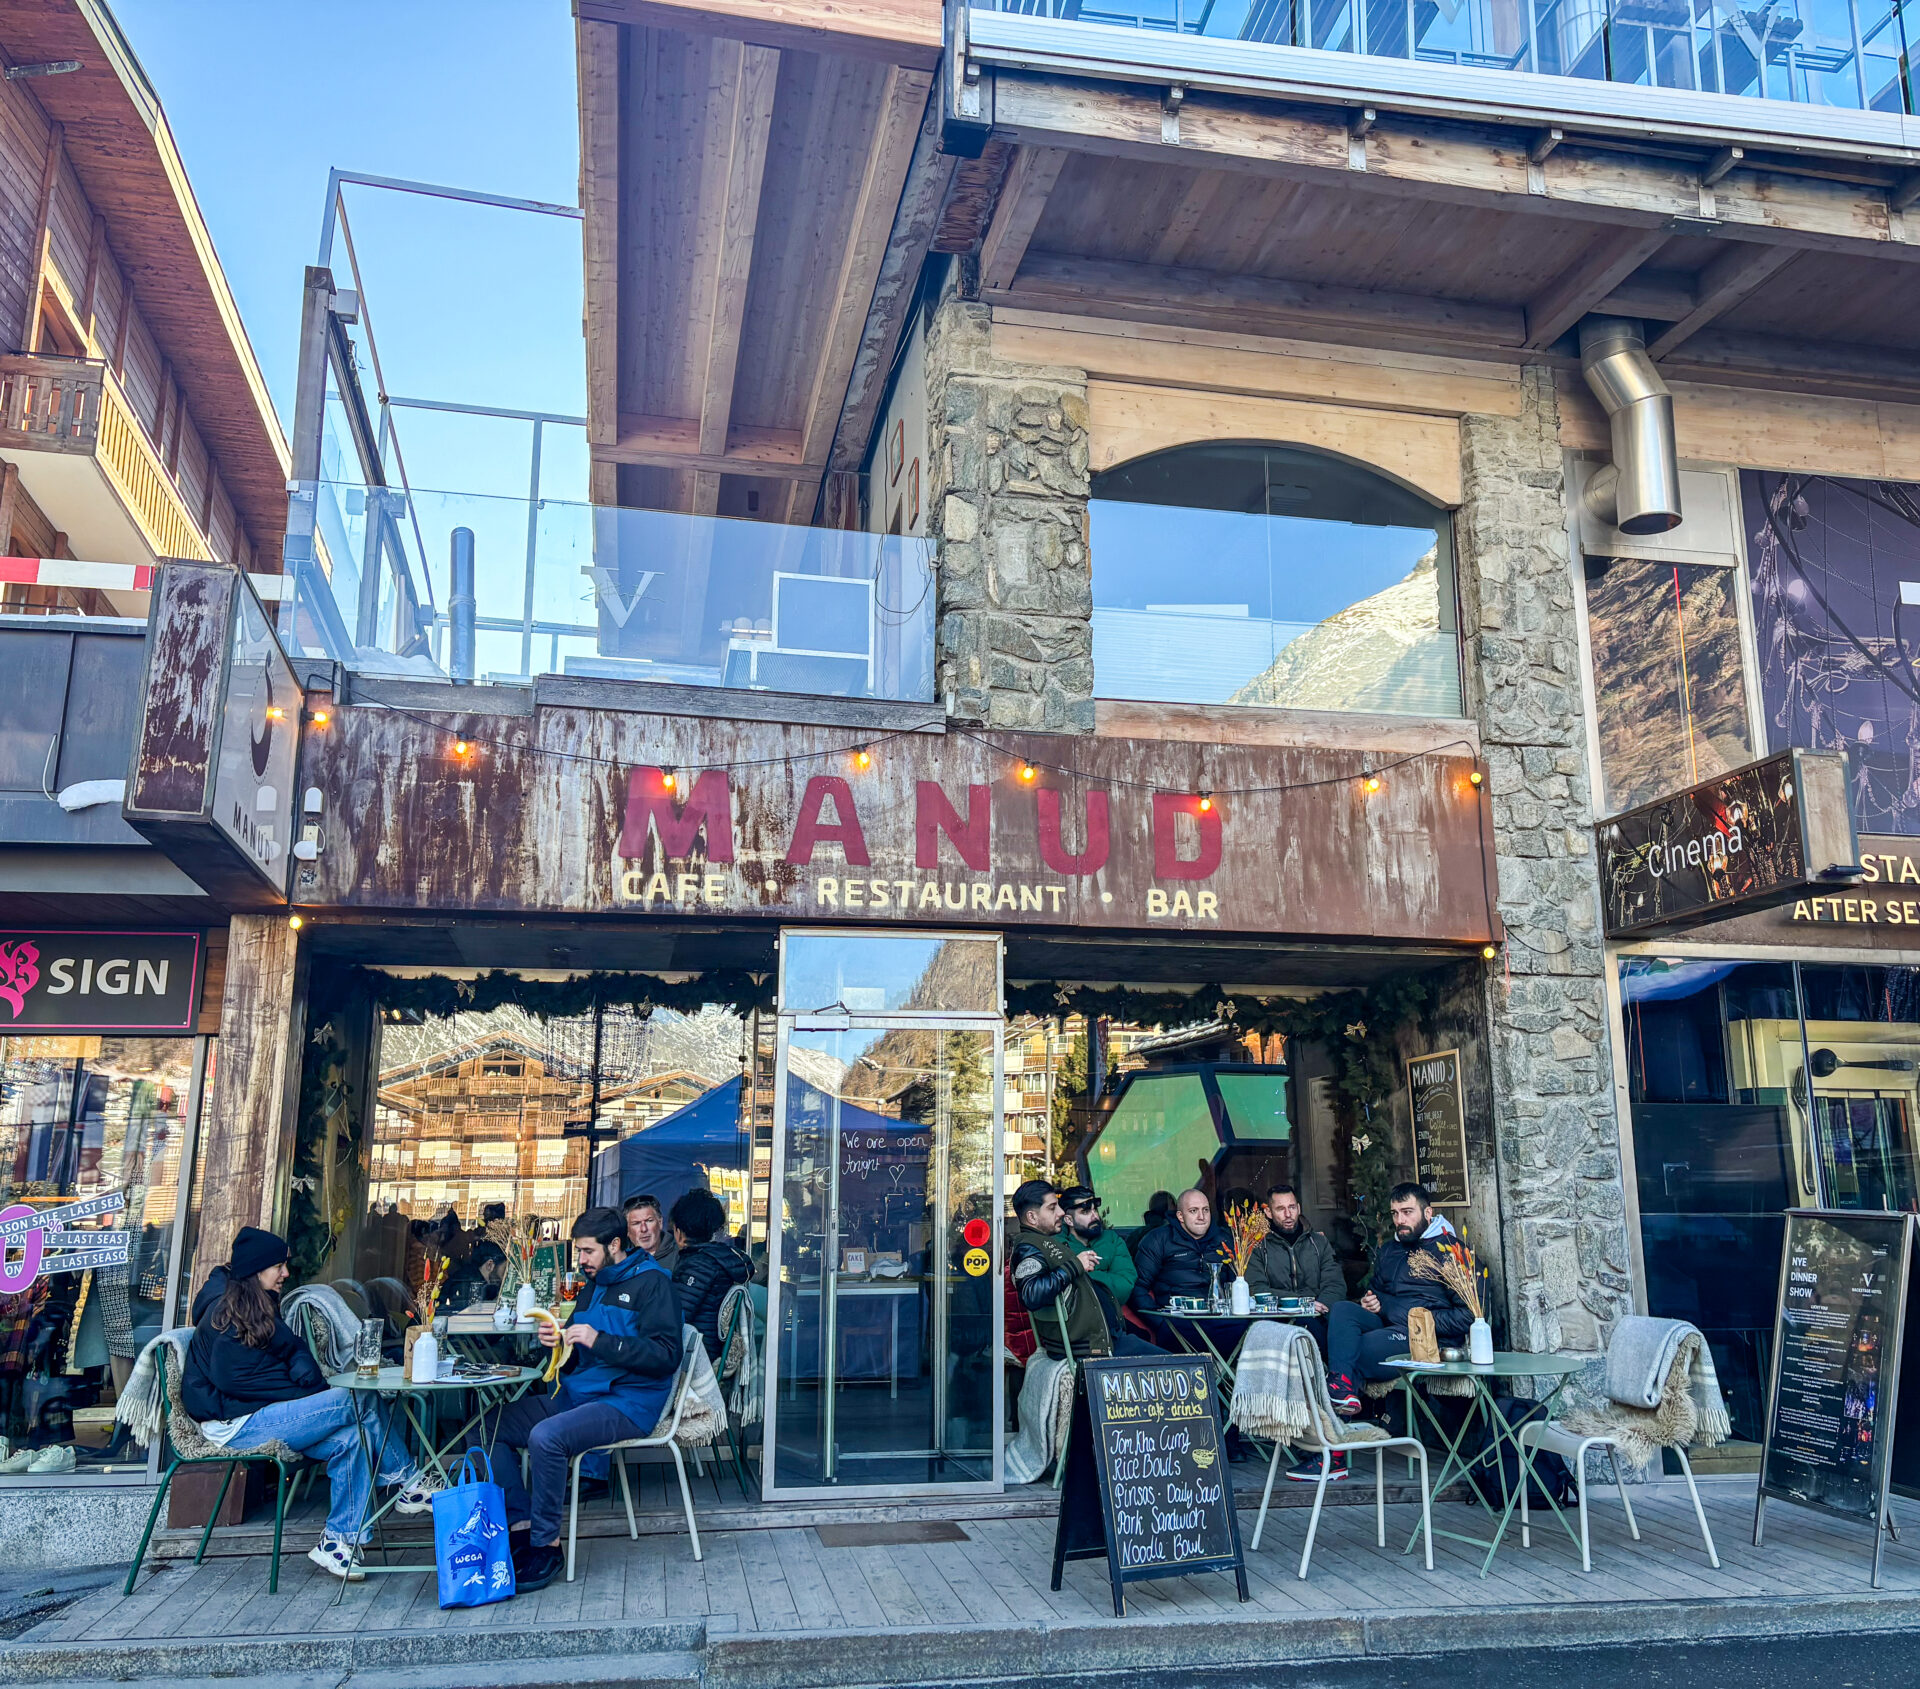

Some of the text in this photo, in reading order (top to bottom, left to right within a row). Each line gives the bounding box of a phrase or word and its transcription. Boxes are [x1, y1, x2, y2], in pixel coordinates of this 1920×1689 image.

[233, 801, 270, 866] MANUD
[618, 765, 1223, 881] MANUD
[1649, 825, 1743, 878] Cinema
[621, 869, 1219, 920] CAFE RESTAURANT BAR
[1793, 898, 1920, 924] AFTER SE
[47, 958, 169, 995] SIGN
[842, 1131, 928, 1156] We are open
[70, 1201, 97, 1217] LAST
[67, 1234, 94, 1244] LAST
[97, 1234, 123, 1244] SEAS
[62, 1256, 89, 1268] LAST
[92, 1251, 127, 1264] SEASO
[847, 1253, 863, 1262] CAKE
[966, 1258, 987, 1267] POP
[1792, 1257, 1808, 1267] NYE
[1790, 1271, 1818, 1284] DINNER
[1789, 1286, 1813, 1298] SHOW
[1106, 1402, 1141, 1420] kitchen
[1171, 1402, 1203, 1417] drinks
[1112, 1451, 1181, 1481] Rice Bowls
[1114, 1477, 1221, 1509] Pinsas Daily Soup
[1117, 1505, 1208, 1536] Pork Sandwich
[454, 1552, 483, 1565] WEGA
[1122, 1533, 1205, 1566] Noodle Bowl
